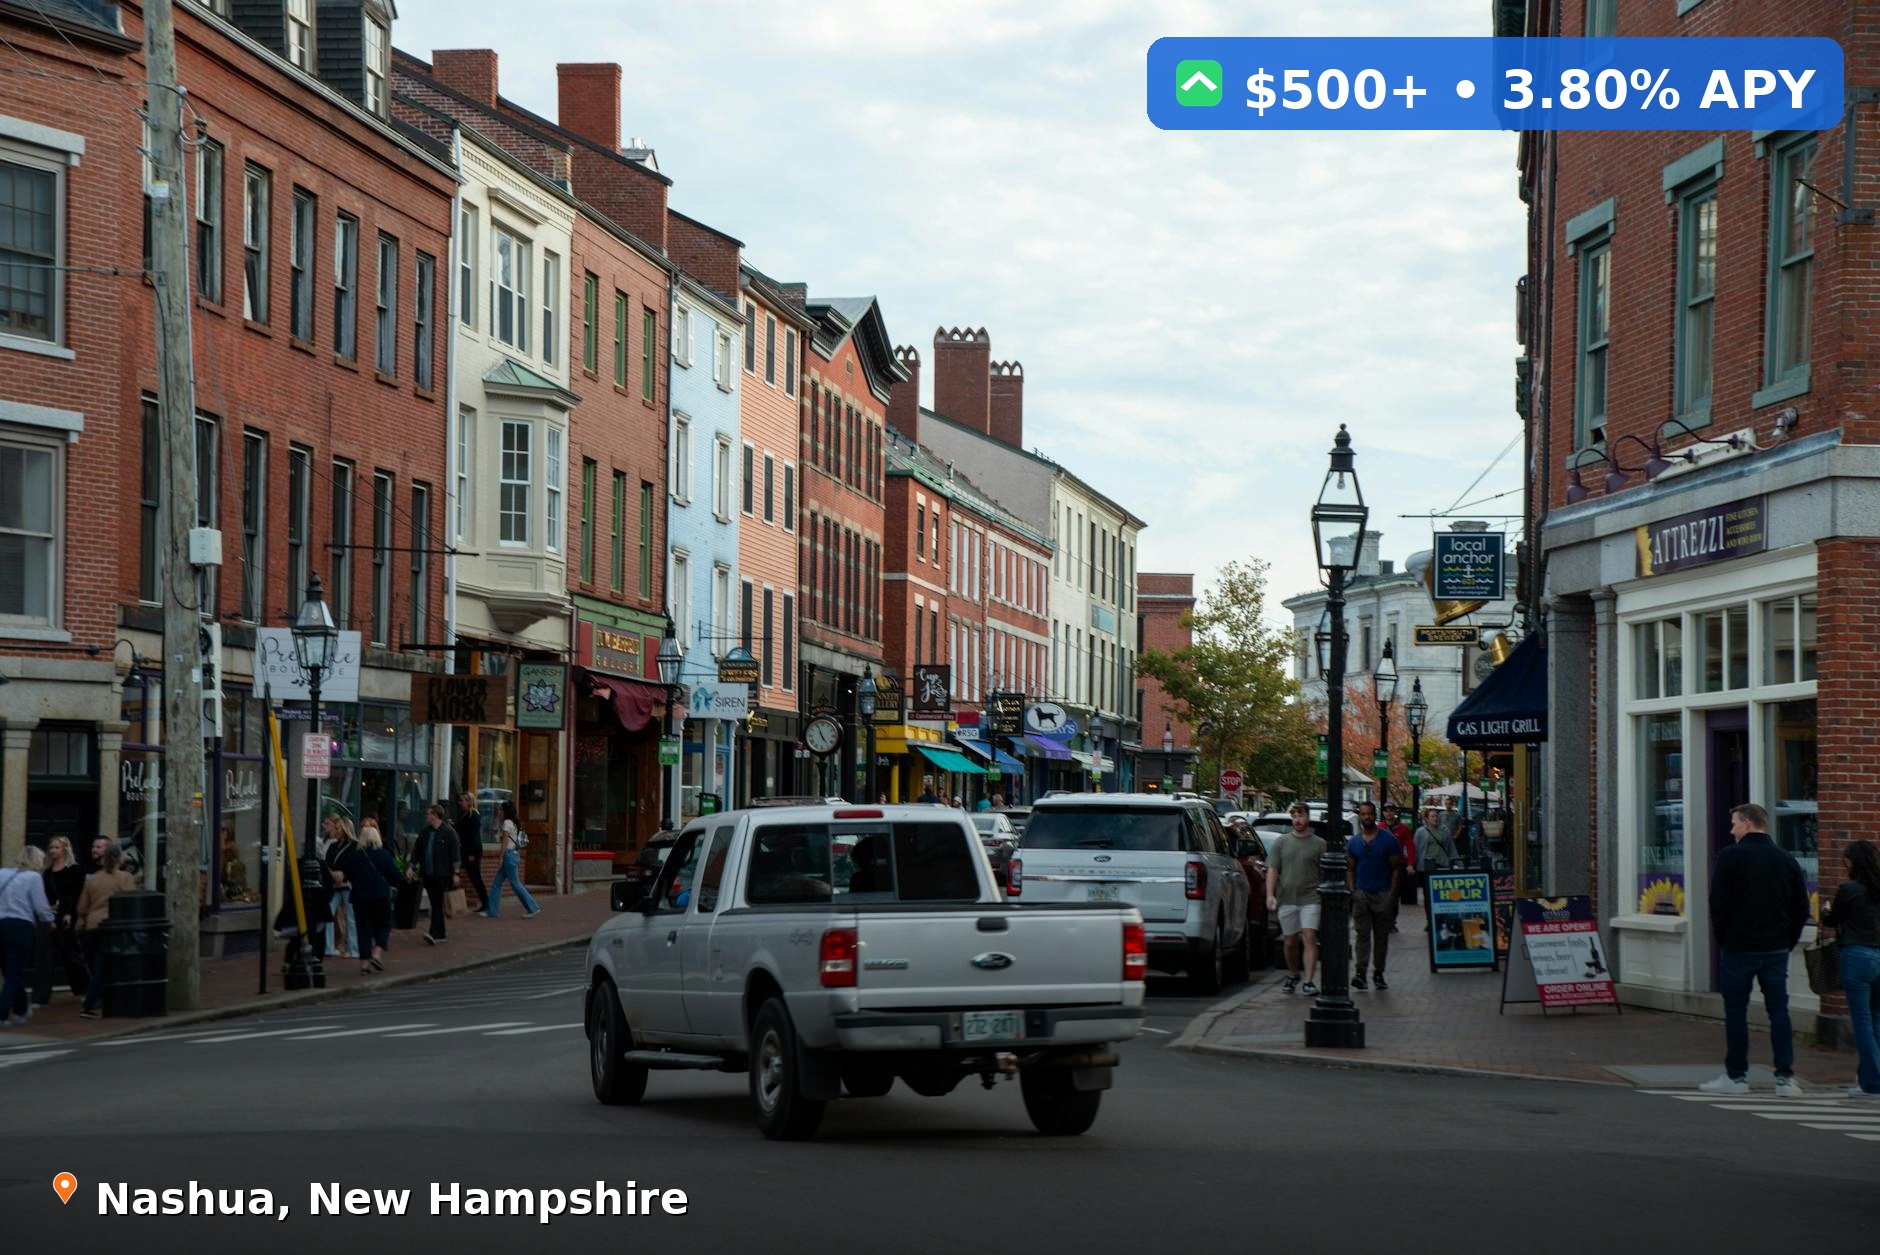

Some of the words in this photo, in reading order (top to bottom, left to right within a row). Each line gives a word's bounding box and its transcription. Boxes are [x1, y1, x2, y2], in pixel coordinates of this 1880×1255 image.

[1451, 537, 1486, 552] local
[1653, 515, 1726, 565] ATTREZZI
[1442, 551, 1496, 564] anchor
[428, 678, 488, 696] FLOWER
[428, 696, 488, 721] KIOSK
[714, 696, 746, 708] SIREN
[1457, 721, 1479, 736] GAS
[1480, 720, 1511, 735] LIGHT
[1512, 718, 1542, 734] GRILL
[1221, 776, 1242, 786] STOP
[1432, 877, 1487, 890] HAPPY
[1439, 888, 1483, 901] HOUR
[1527, 924, 1543, 934] WE
[1543, 923, 1561, 933] ARE
[1544, 984, 1575, 994] ORDER
[1576, 982, 1608, 993] ONLINE
